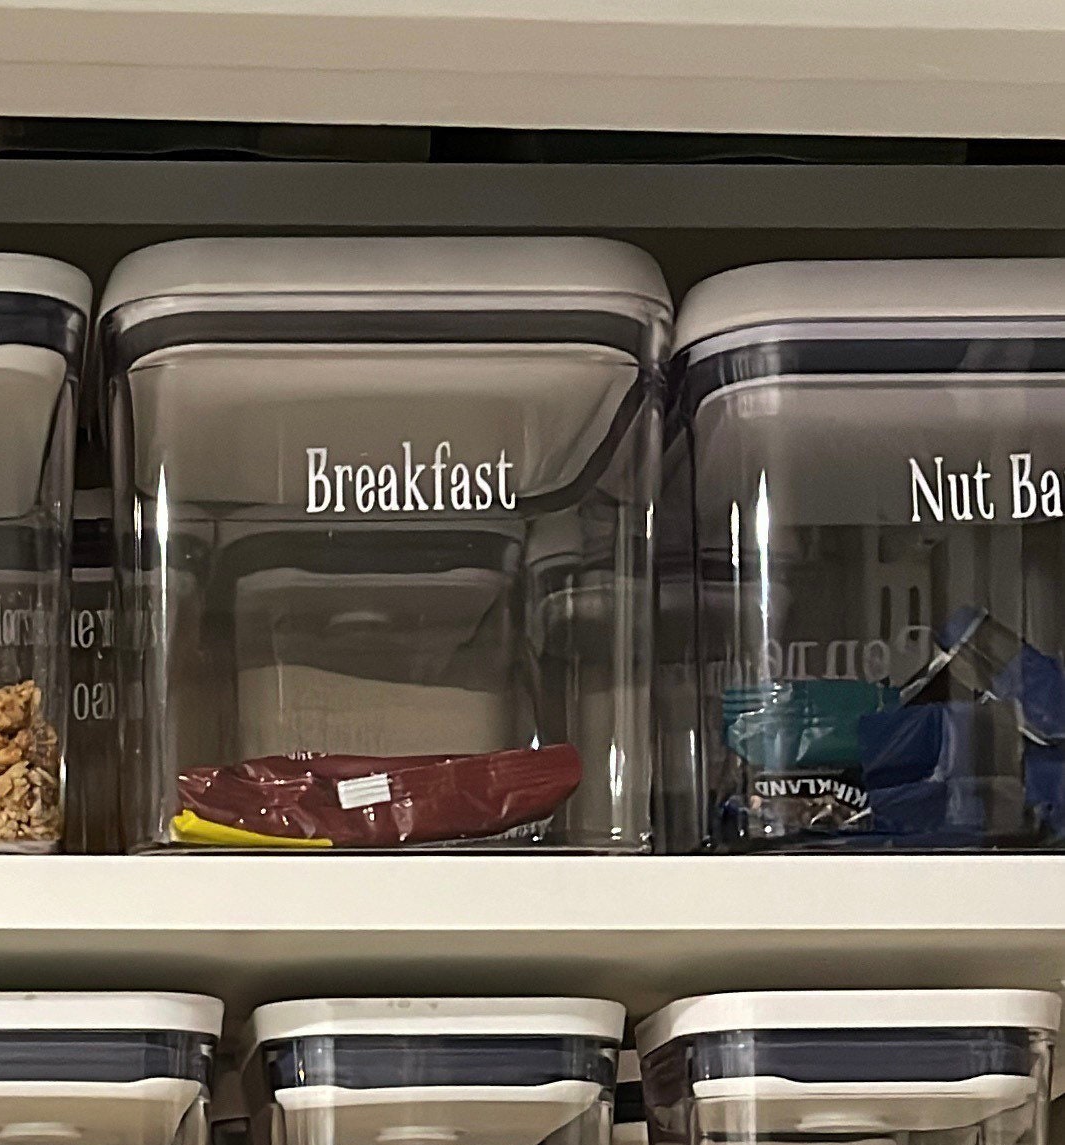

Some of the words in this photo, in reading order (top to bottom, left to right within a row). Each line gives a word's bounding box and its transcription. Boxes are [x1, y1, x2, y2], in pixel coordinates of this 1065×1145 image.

[305, 441, 516, 513] Breakfast
[908, 457, 995, 522] Nut
[1009, 452, 1065, 519] Ba
[754, 778, 869, 808] KIRKLAND
